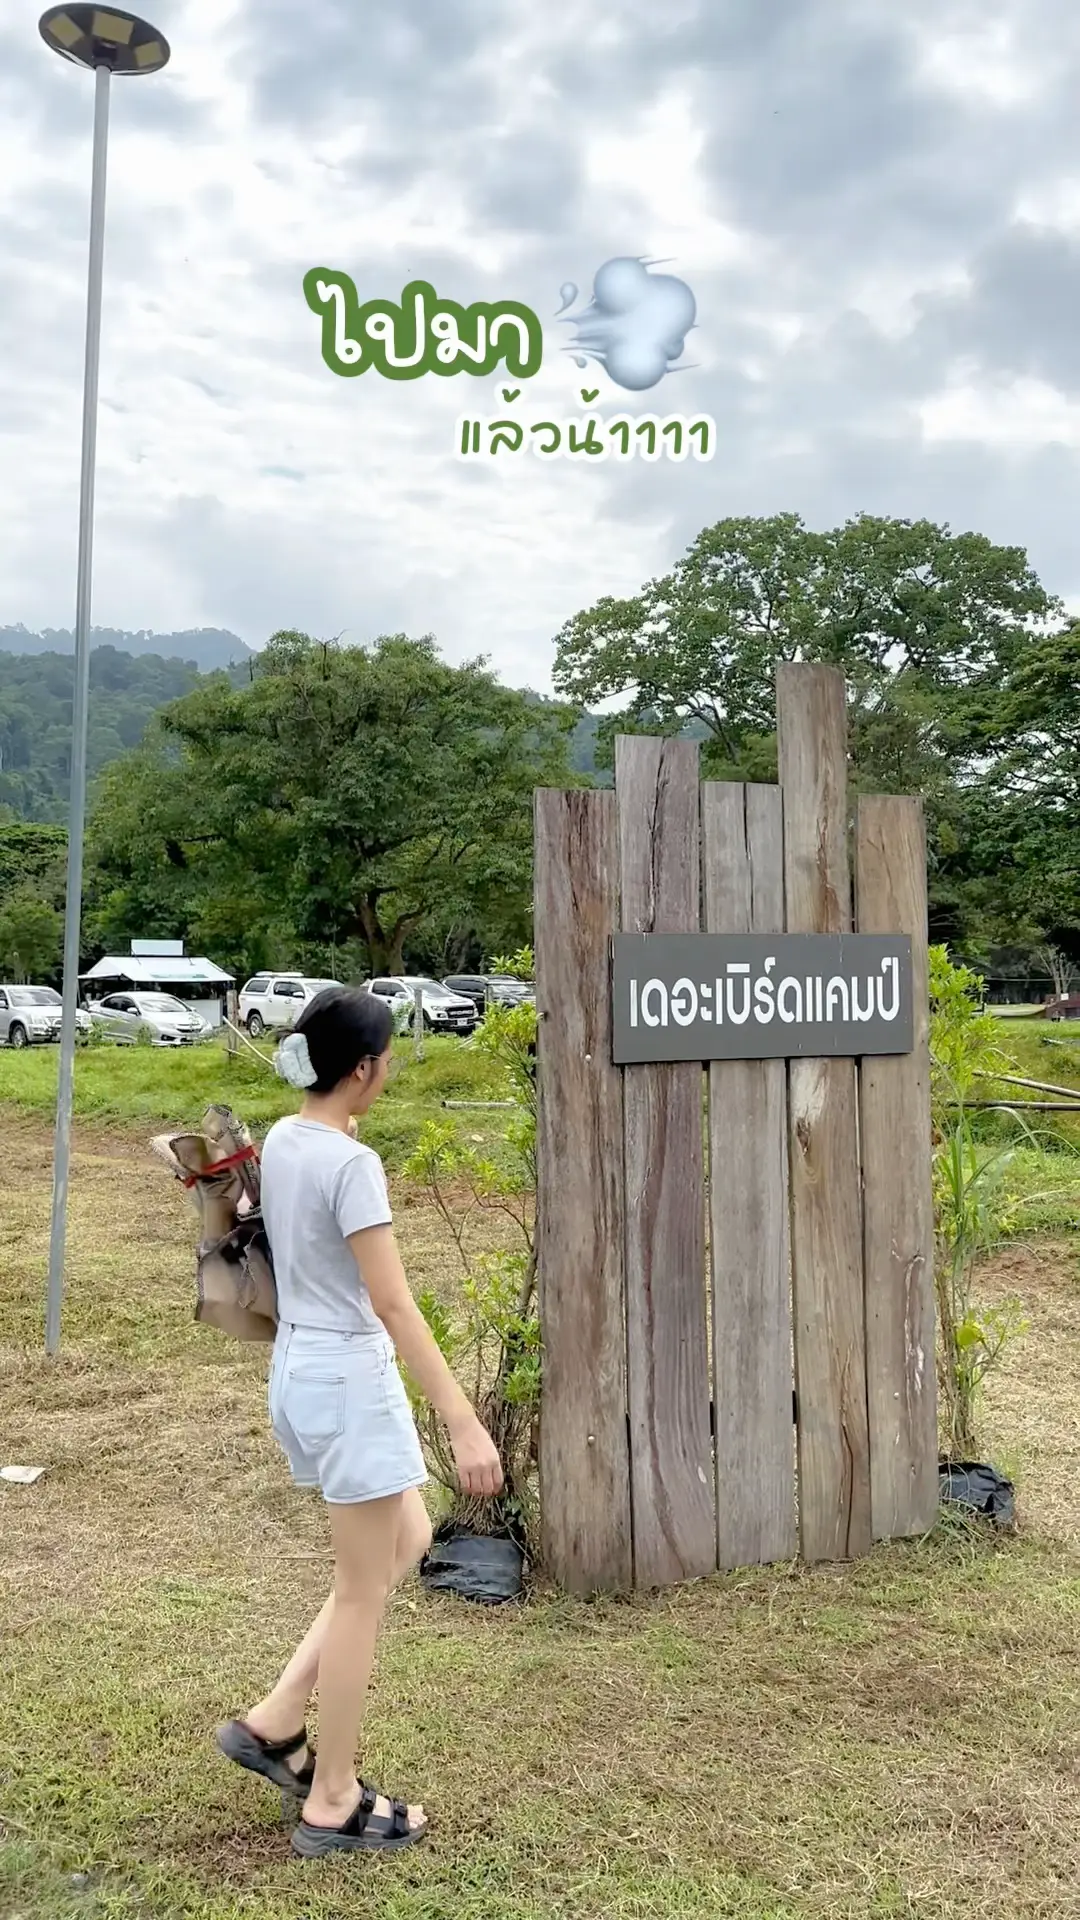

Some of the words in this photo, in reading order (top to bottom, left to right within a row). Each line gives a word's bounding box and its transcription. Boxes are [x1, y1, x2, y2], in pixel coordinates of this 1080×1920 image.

[630, 956, 900, 1027] เดอะเบิร์ดแคมป์
